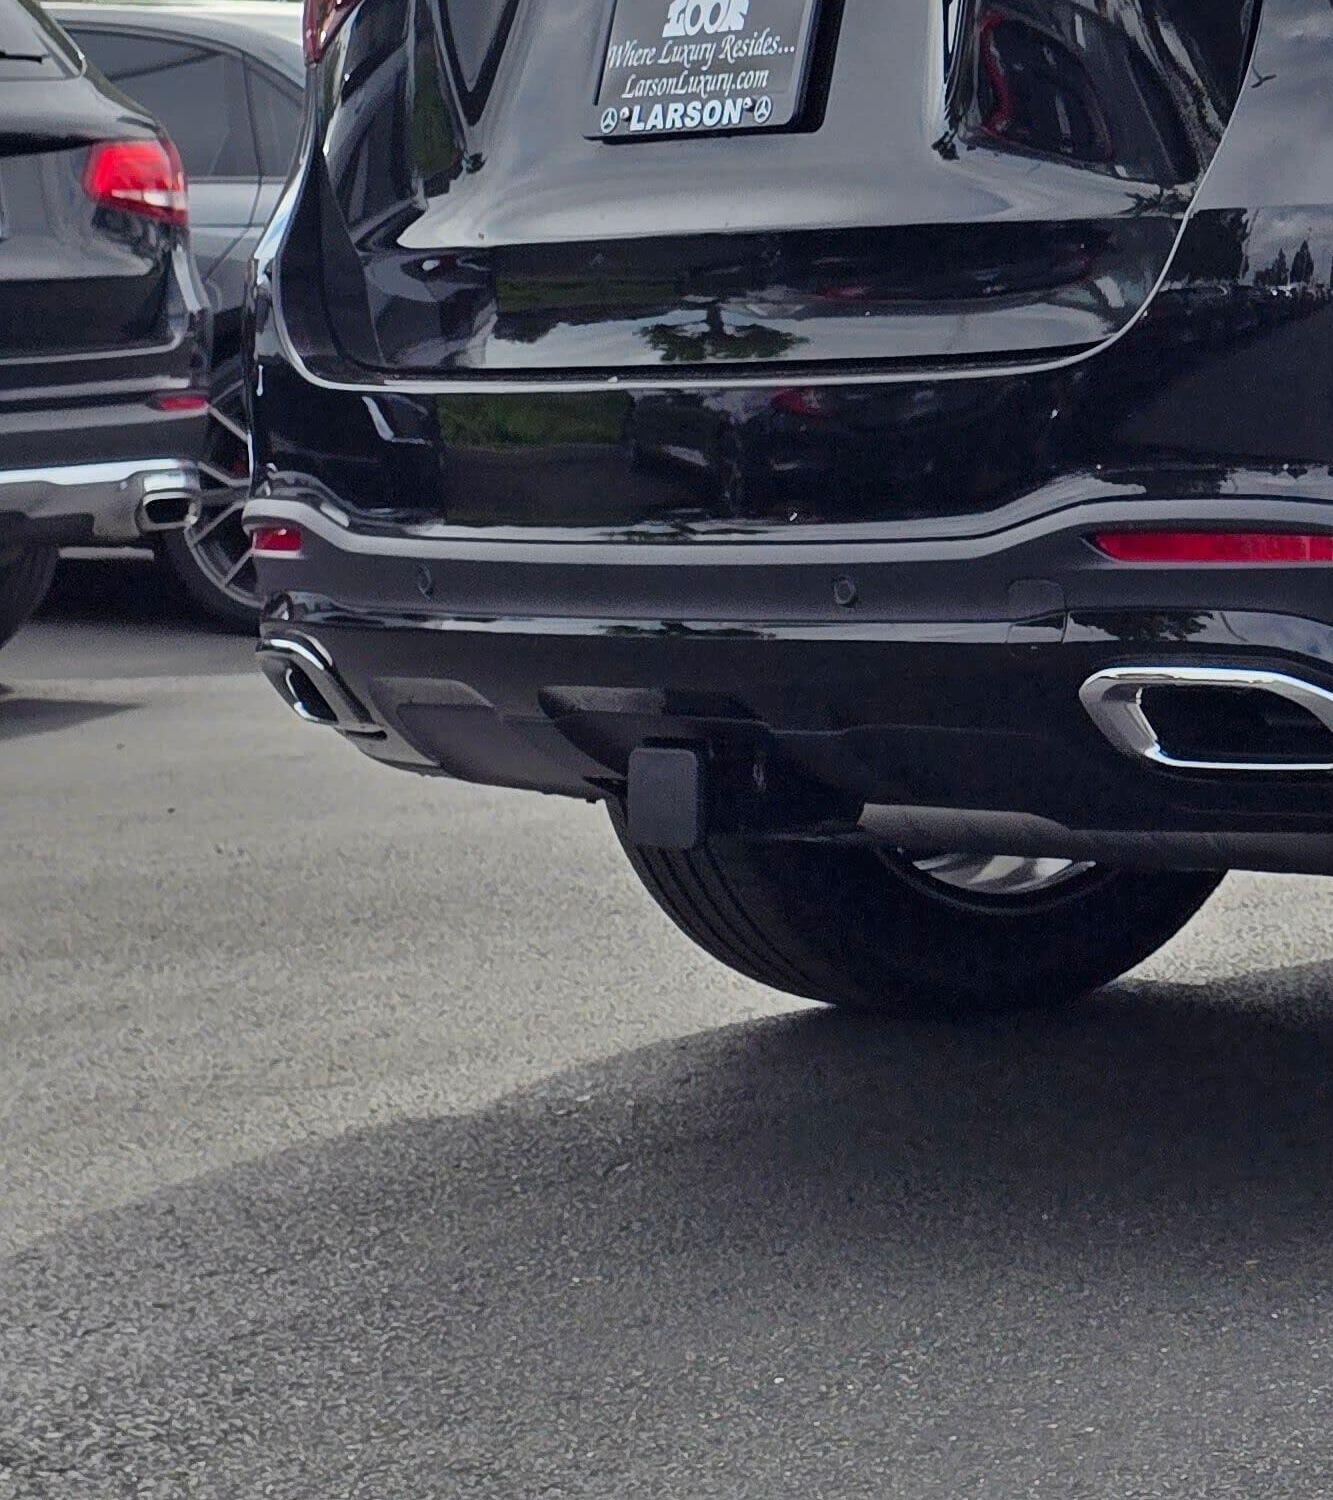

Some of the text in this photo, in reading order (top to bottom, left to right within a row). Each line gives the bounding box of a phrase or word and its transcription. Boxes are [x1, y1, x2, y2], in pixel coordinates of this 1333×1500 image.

[607, 28, 796, 71] Where Luxury Resides...
[621, 69, 770, 99] LarsonLuxury.com
[629, 97, 744, 131] LARSON
